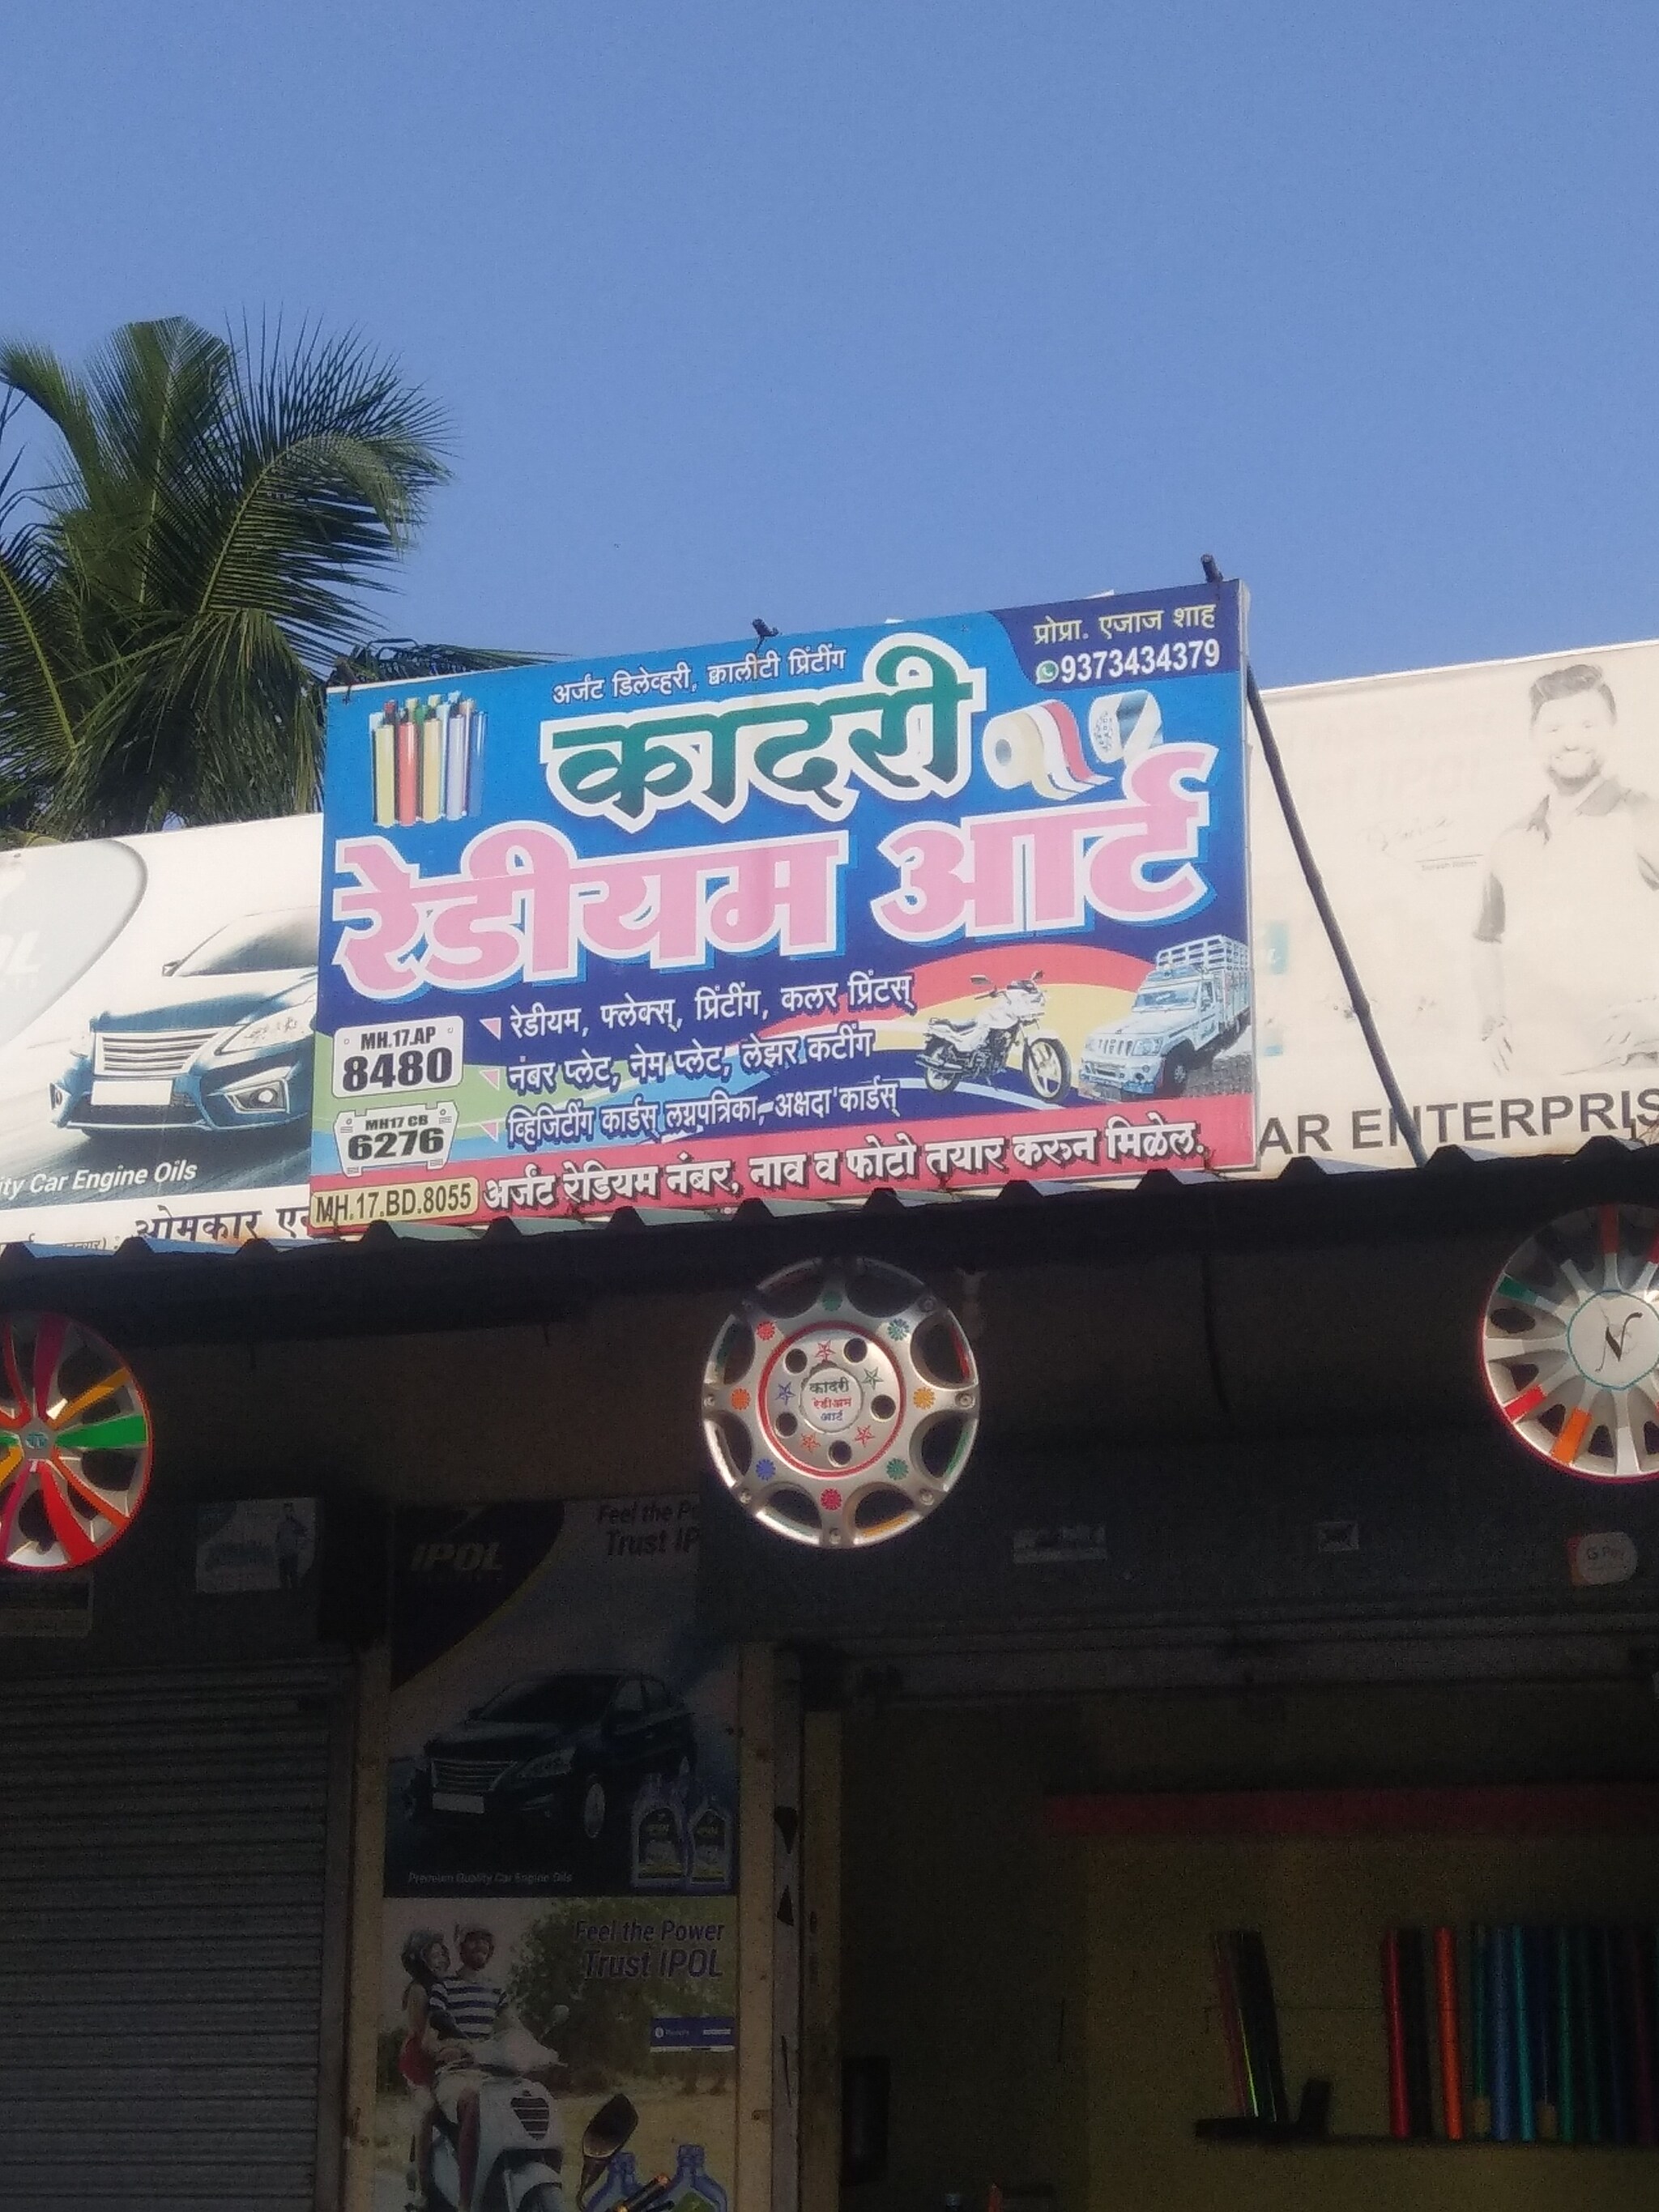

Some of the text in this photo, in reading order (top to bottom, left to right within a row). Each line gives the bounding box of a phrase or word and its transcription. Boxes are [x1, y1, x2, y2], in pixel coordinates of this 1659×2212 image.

[1033, 603, 1215, 646] प्रोप्रा. एजाज शाह
[1060, 638, 1221, 683] 9373434379
[552, 672, 604, 705] अर्जंट
[539, 633, 987, 833] कादरी
[331, 743, 1218, 999] रेडीयम आर्ट
[510, 1004, 588, 1038] रेडीयम,
[781, 978, 839, 1014] कलर
[342, 1046, 453, 1092] 8480
[509, 1055, 556, 1093] नंबर
[565, 1051, 619, 1088] प्लेट,
[630, 1042, 666, 1077] नेम
[742, 1030, 798, 1070] लेझर
[365, 1116, 404, 1132] MH17
[348, 1127, 444, 1161] 6276
[30, 1170, 68, 1193] Car
[72, 1165, 148, 1193] Engine
[154, 1159, 198, 1183] Oils
[484, 1166, 556, 1209] अर्जंट
[563, 1160, 658, 1201] रेडियम
[667, 1150, 740, 1196] नंबर,
[749, 1153, 805, 1187] नाव
[812, 1150, 837, 1183] व
[846, 1131, 916, 1179] फोटो
[925, 1136, 1004, 1174] तयार
[316, 1183, 472, 1224] MH.17.BD.8055
[809, 1377, 849, 1394] कादरी
[409, 1542, 502, 1572] IPOL
[607, 1528, 667, 1556] Trust
[574, 1918, 726, 1942] Feel the Power
[585, 1947, 724, 1979] Trust IPOL
